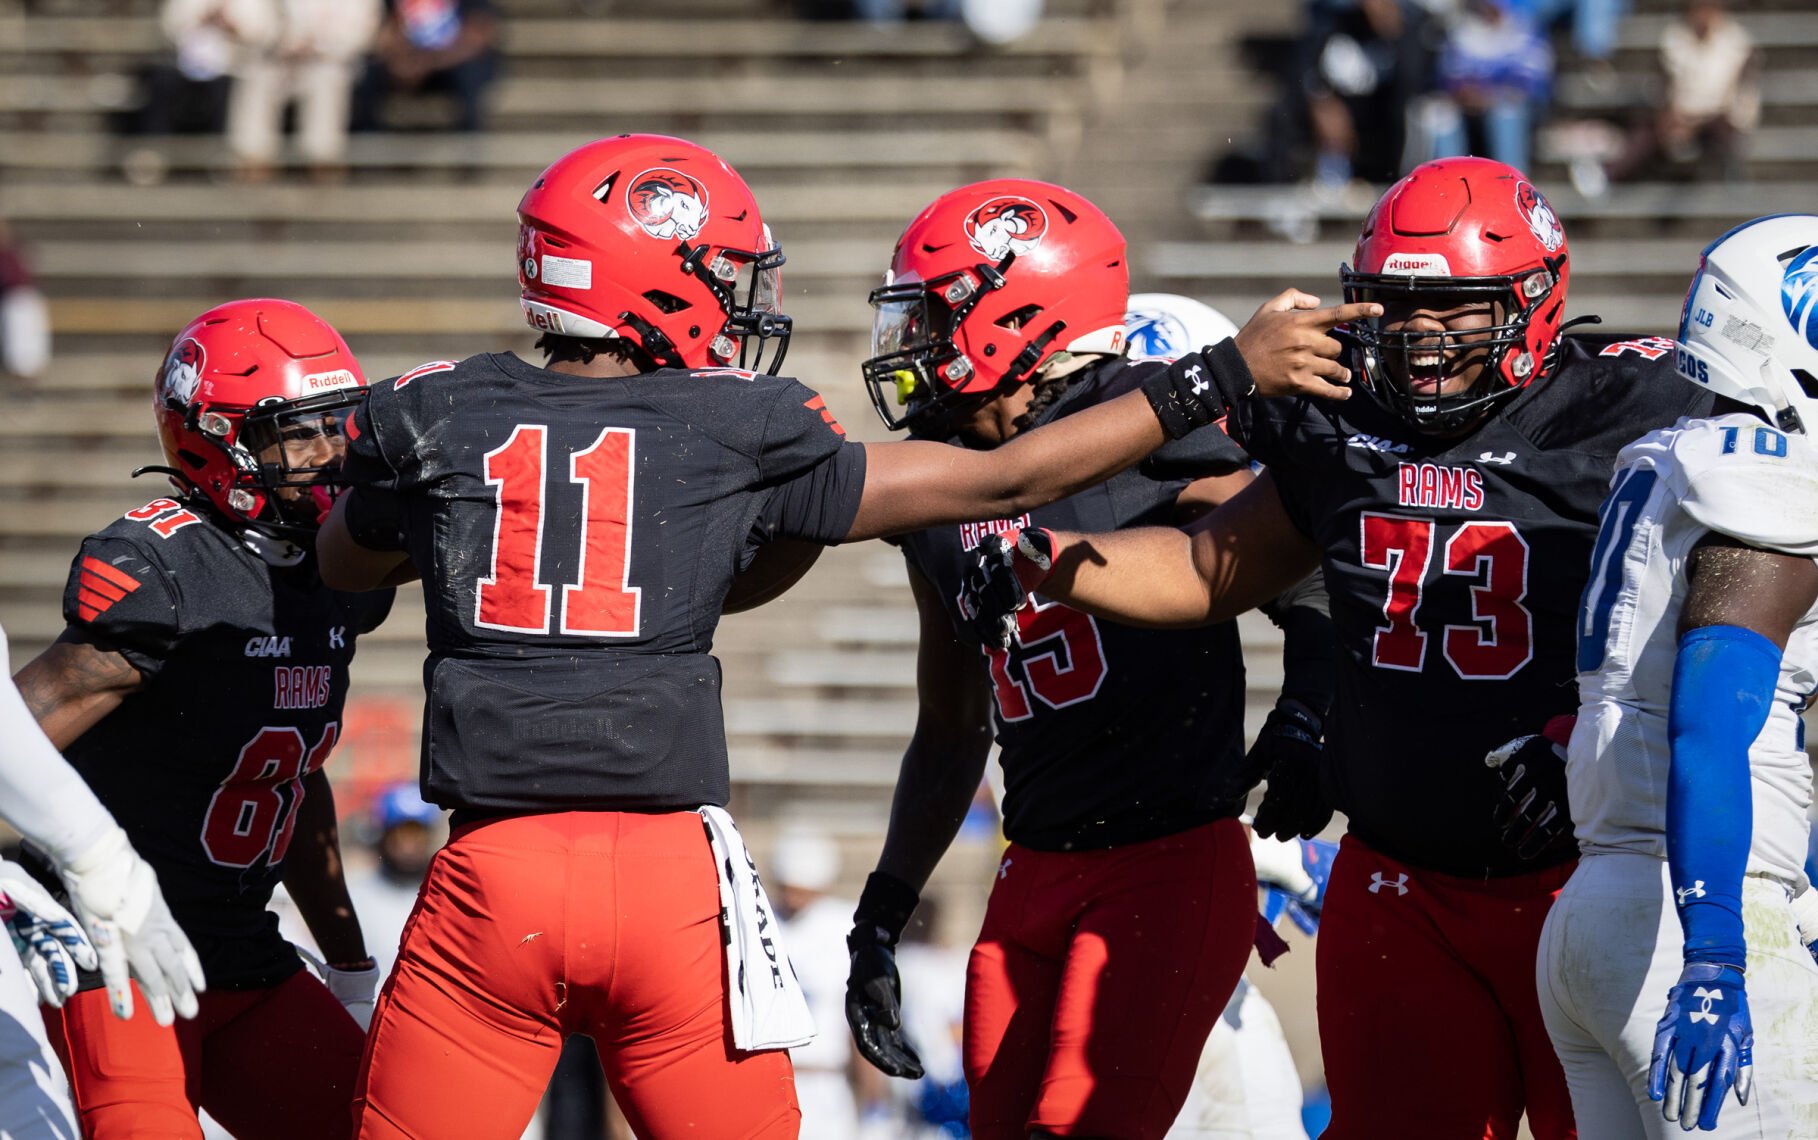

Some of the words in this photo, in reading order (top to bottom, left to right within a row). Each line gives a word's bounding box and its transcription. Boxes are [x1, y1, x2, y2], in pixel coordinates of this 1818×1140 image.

[1694, 308, 1715, 329] JLB
[309, 372, 352, 389] Riddell
[1719, 425, 1789, 459] 10
[1399, 461, 1485, 512] RAMS
[125, 498, 202, 540] 81
[474, 423, 642, 638] 11
[1360, 510, 1534, 680] 73
[273, 665, 332, 710] RAMS
[200, 721, 339, 869] 81
